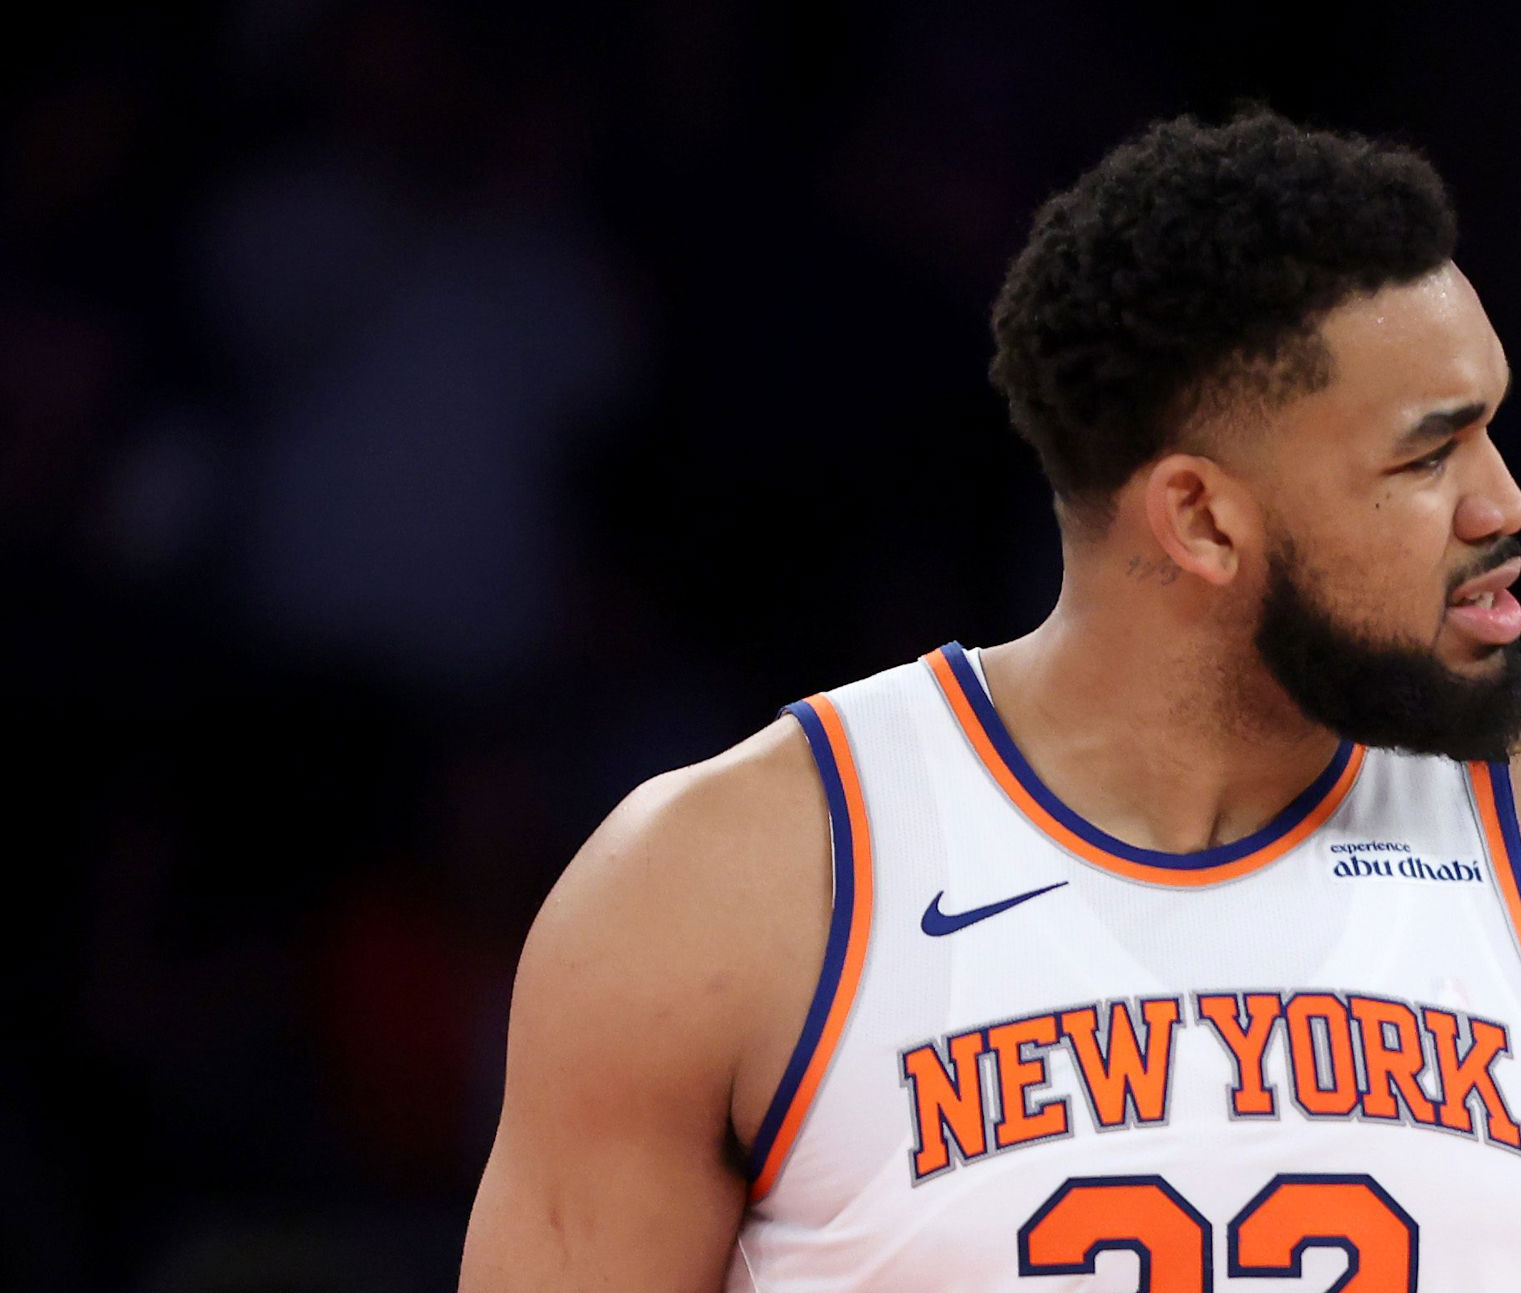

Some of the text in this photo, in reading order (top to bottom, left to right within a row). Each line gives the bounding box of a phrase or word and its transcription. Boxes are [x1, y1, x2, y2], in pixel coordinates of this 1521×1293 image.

[1330, 840, 1411, 854] experience
[1333, 855, 1483, 882] abu dhabi
[900, 995, 1186, 1187] NEW
